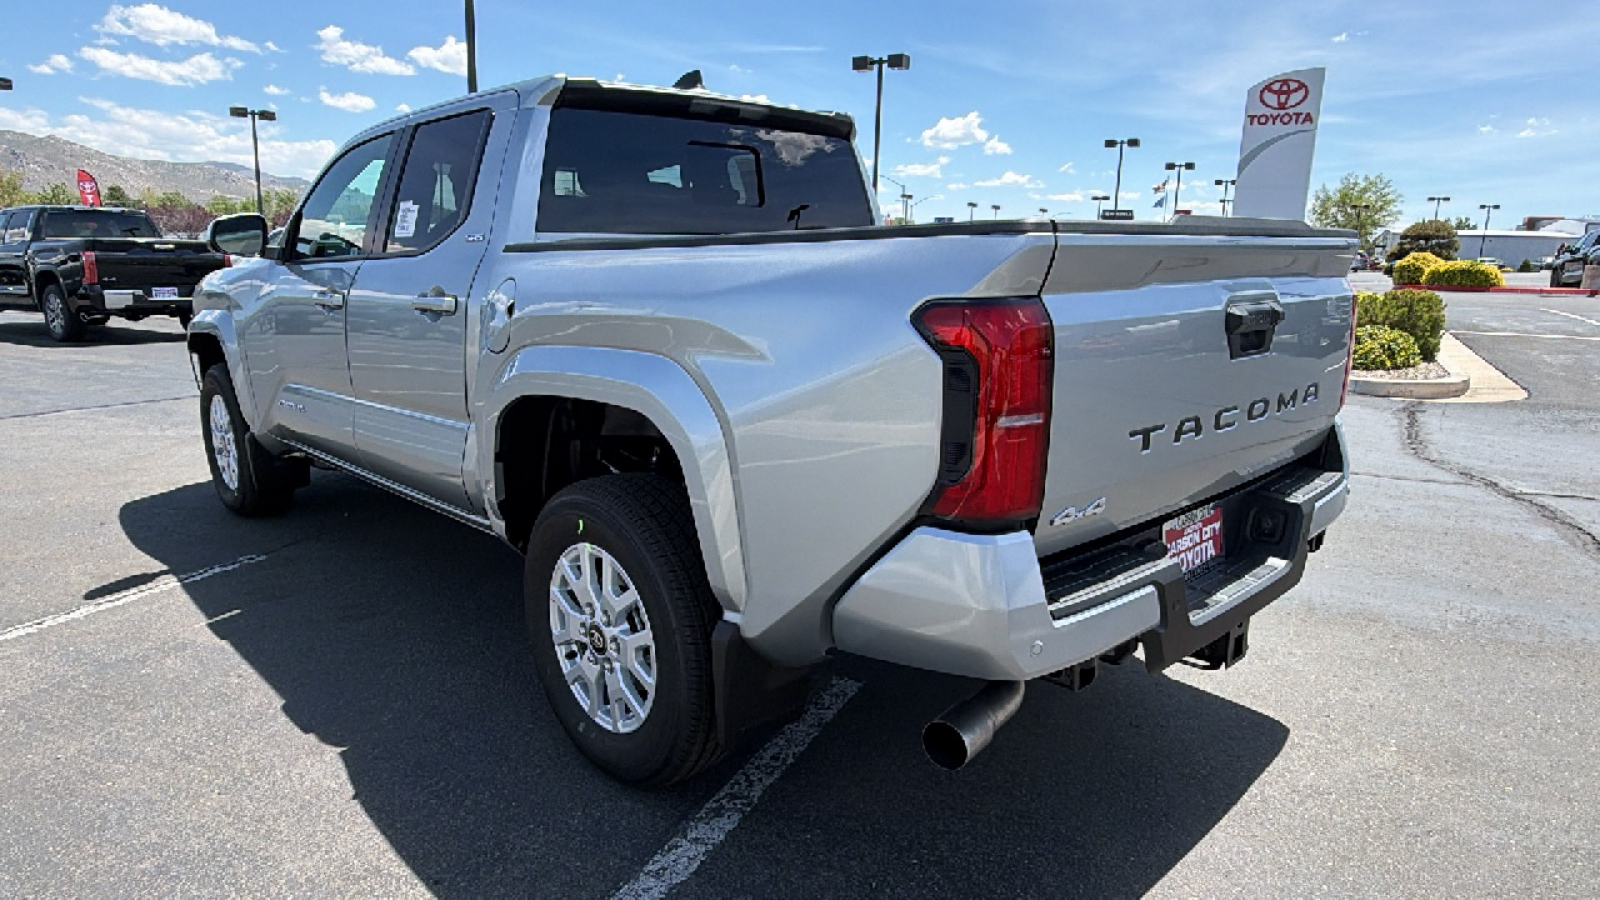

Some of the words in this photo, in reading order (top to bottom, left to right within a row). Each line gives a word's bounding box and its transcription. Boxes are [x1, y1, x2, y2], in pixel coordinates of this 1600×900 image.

[1247, 112, 1314, 126] TOYOTA
[1129, 382, 1319, 453] TACOMA
[1202, 521, 1221, 540] CITY
[1174, 540, 1216, 571] OYOTA
